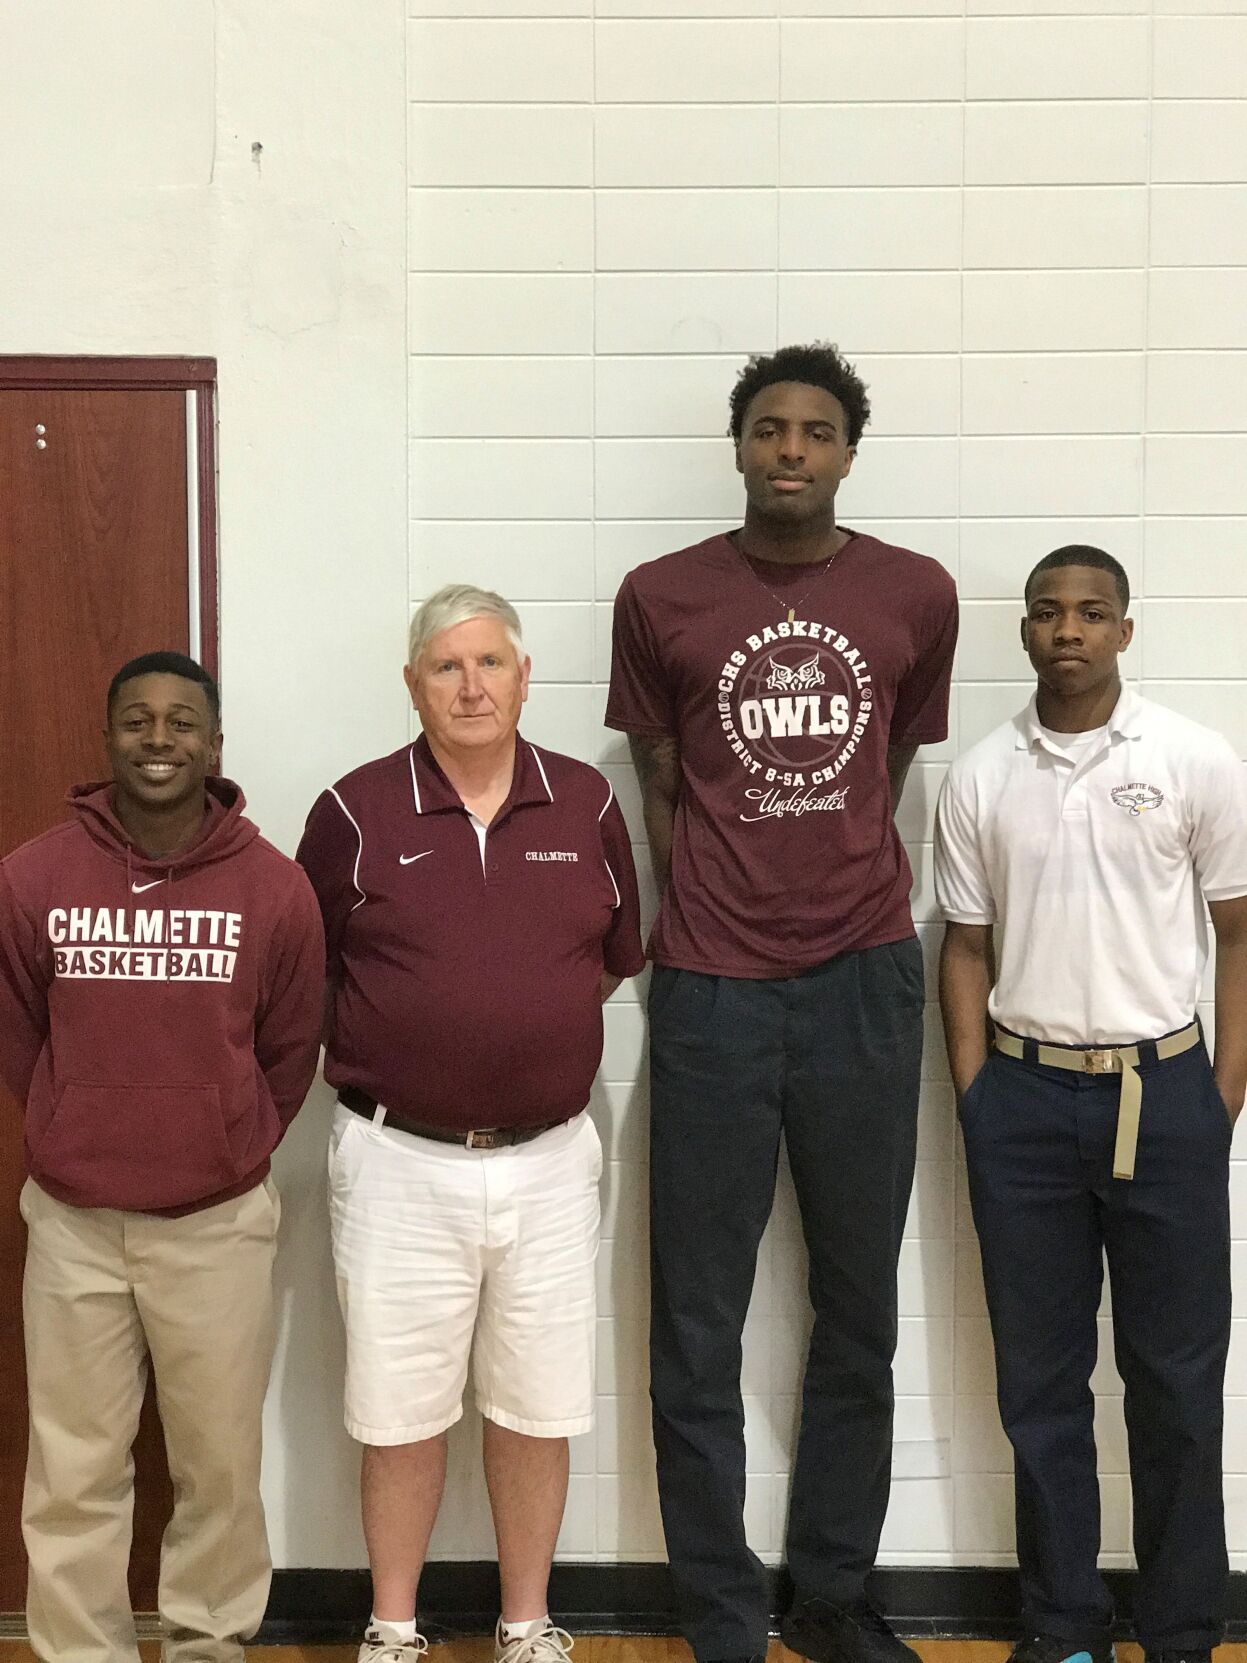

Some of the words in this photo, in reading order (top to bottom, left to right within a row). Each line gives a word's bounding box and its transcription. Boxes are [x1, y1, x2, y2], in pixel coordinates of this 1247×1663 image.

[718, 650, 747, 692] CHS
[746, 620, 872, 689] BASKETBALL
[740, 695, 849, 740] OWLS
[718, 702, 762, 774] DISTRICT
[811, 700, 872, 785] CHAMPIONS
[740, 786, 850, 822] Undefeated
[525, 851, 578, 861] CHALMETTE
[48, 907, 242, 947] CHALMETTE
[54, 950, 233, 979] BASKETBALL
